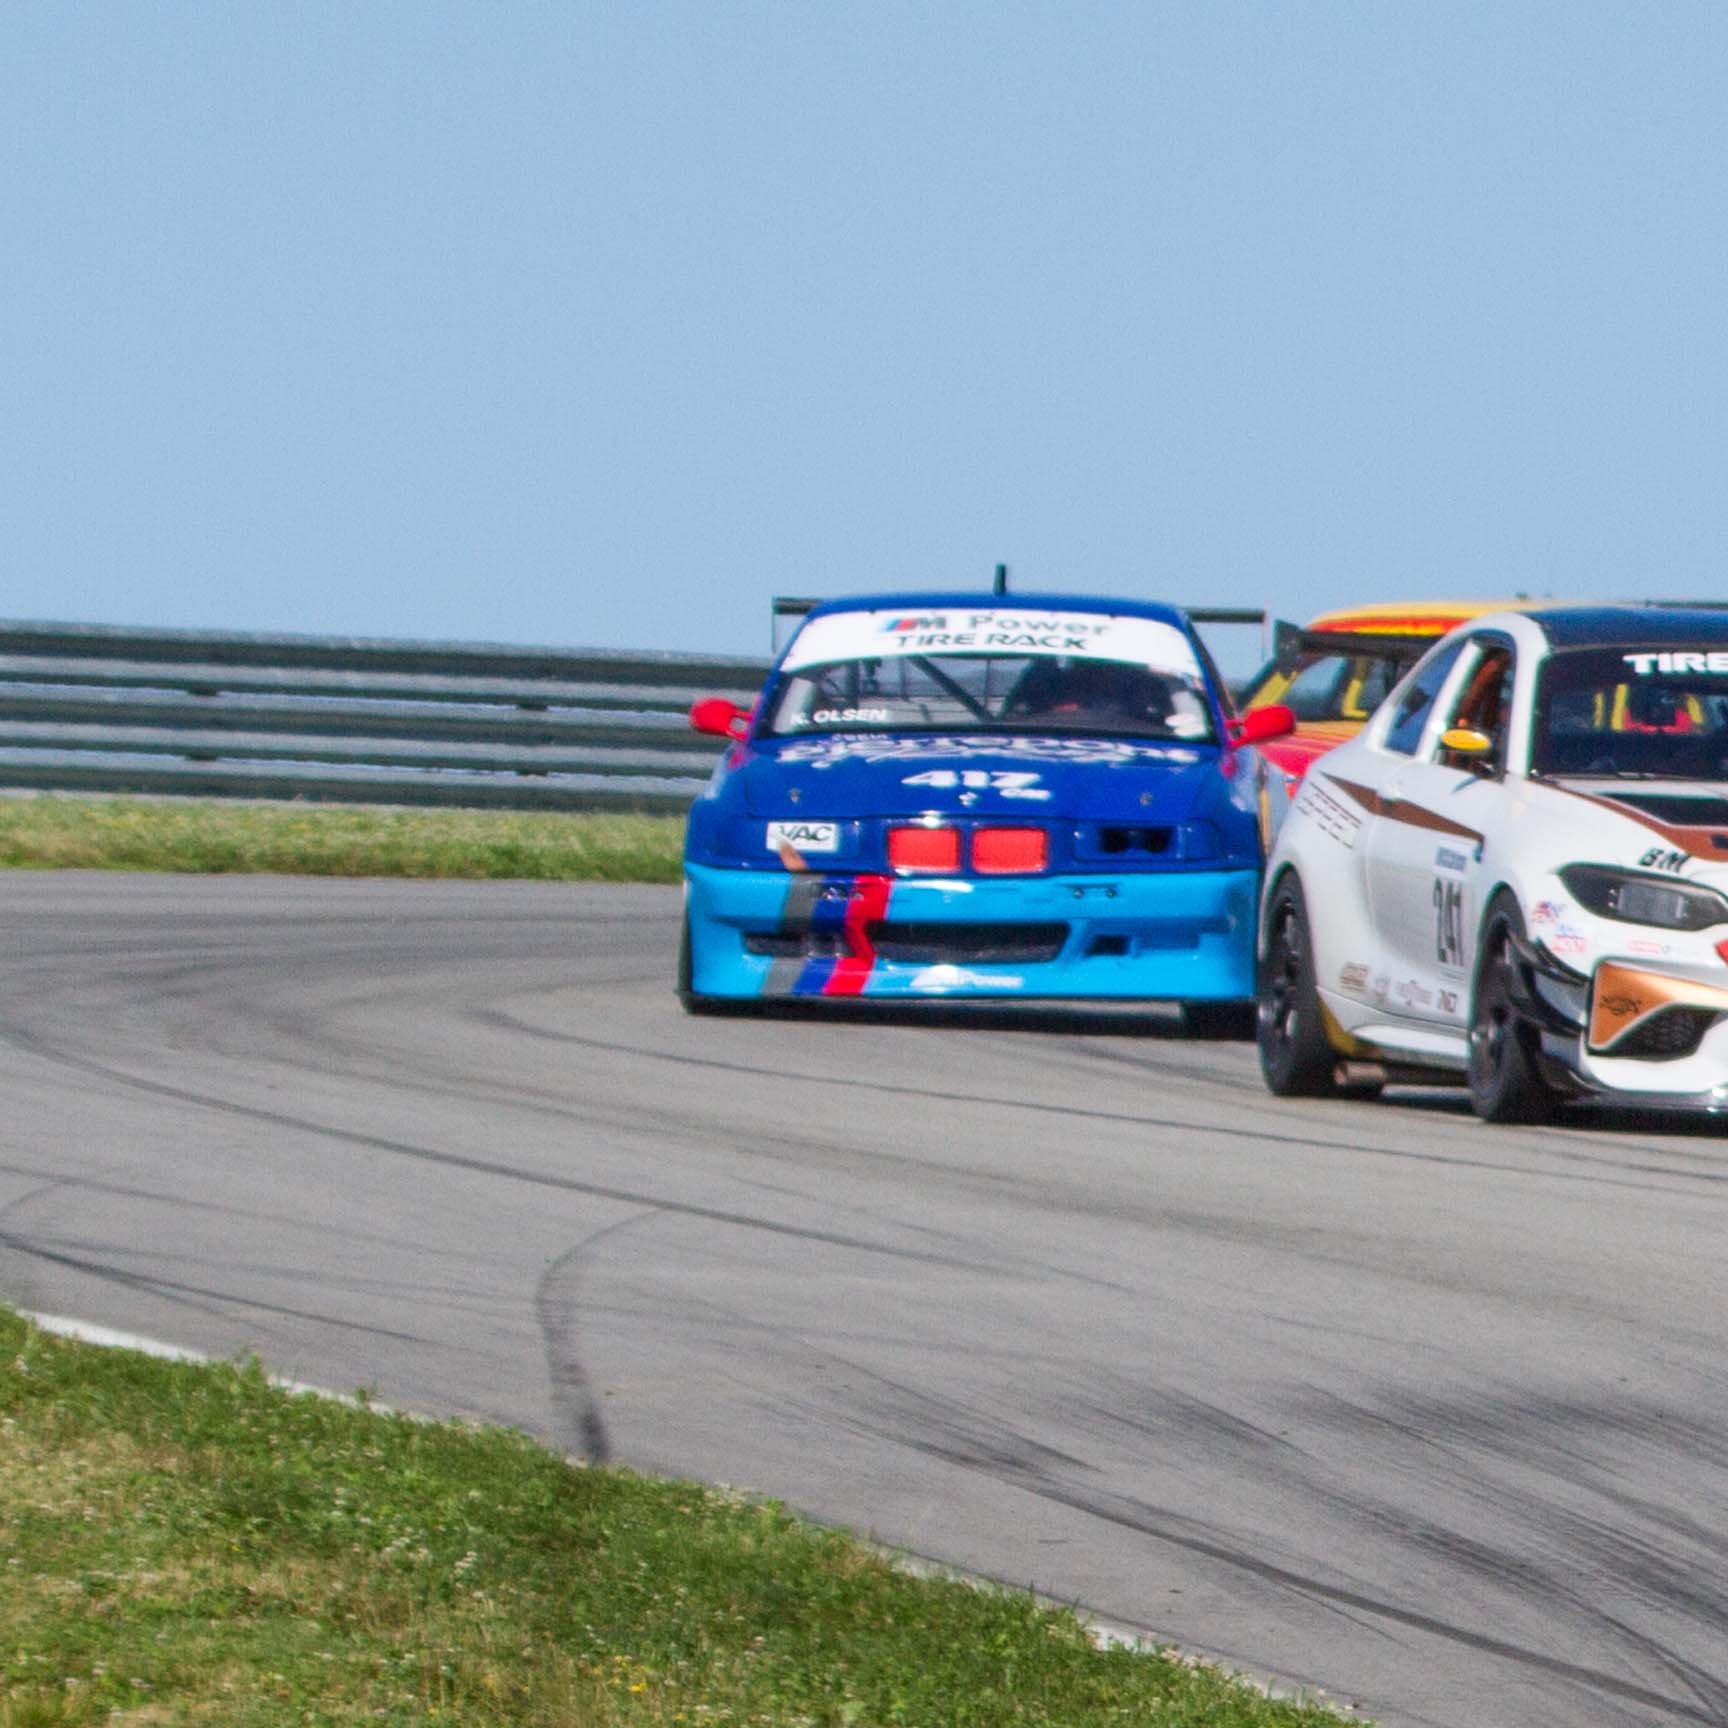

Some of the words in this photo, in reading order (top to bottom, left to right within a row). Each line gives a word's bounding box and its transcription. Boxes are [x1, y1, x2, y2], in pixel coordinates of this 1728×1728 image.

[968, 614, 1108, 635] Power
[895, 633, 976, 648] TIRE
[984, 632, 1088, 650] RACK
[812, 708, 888, 724] OLSEN
[900, 770, 1042, 789] 417
